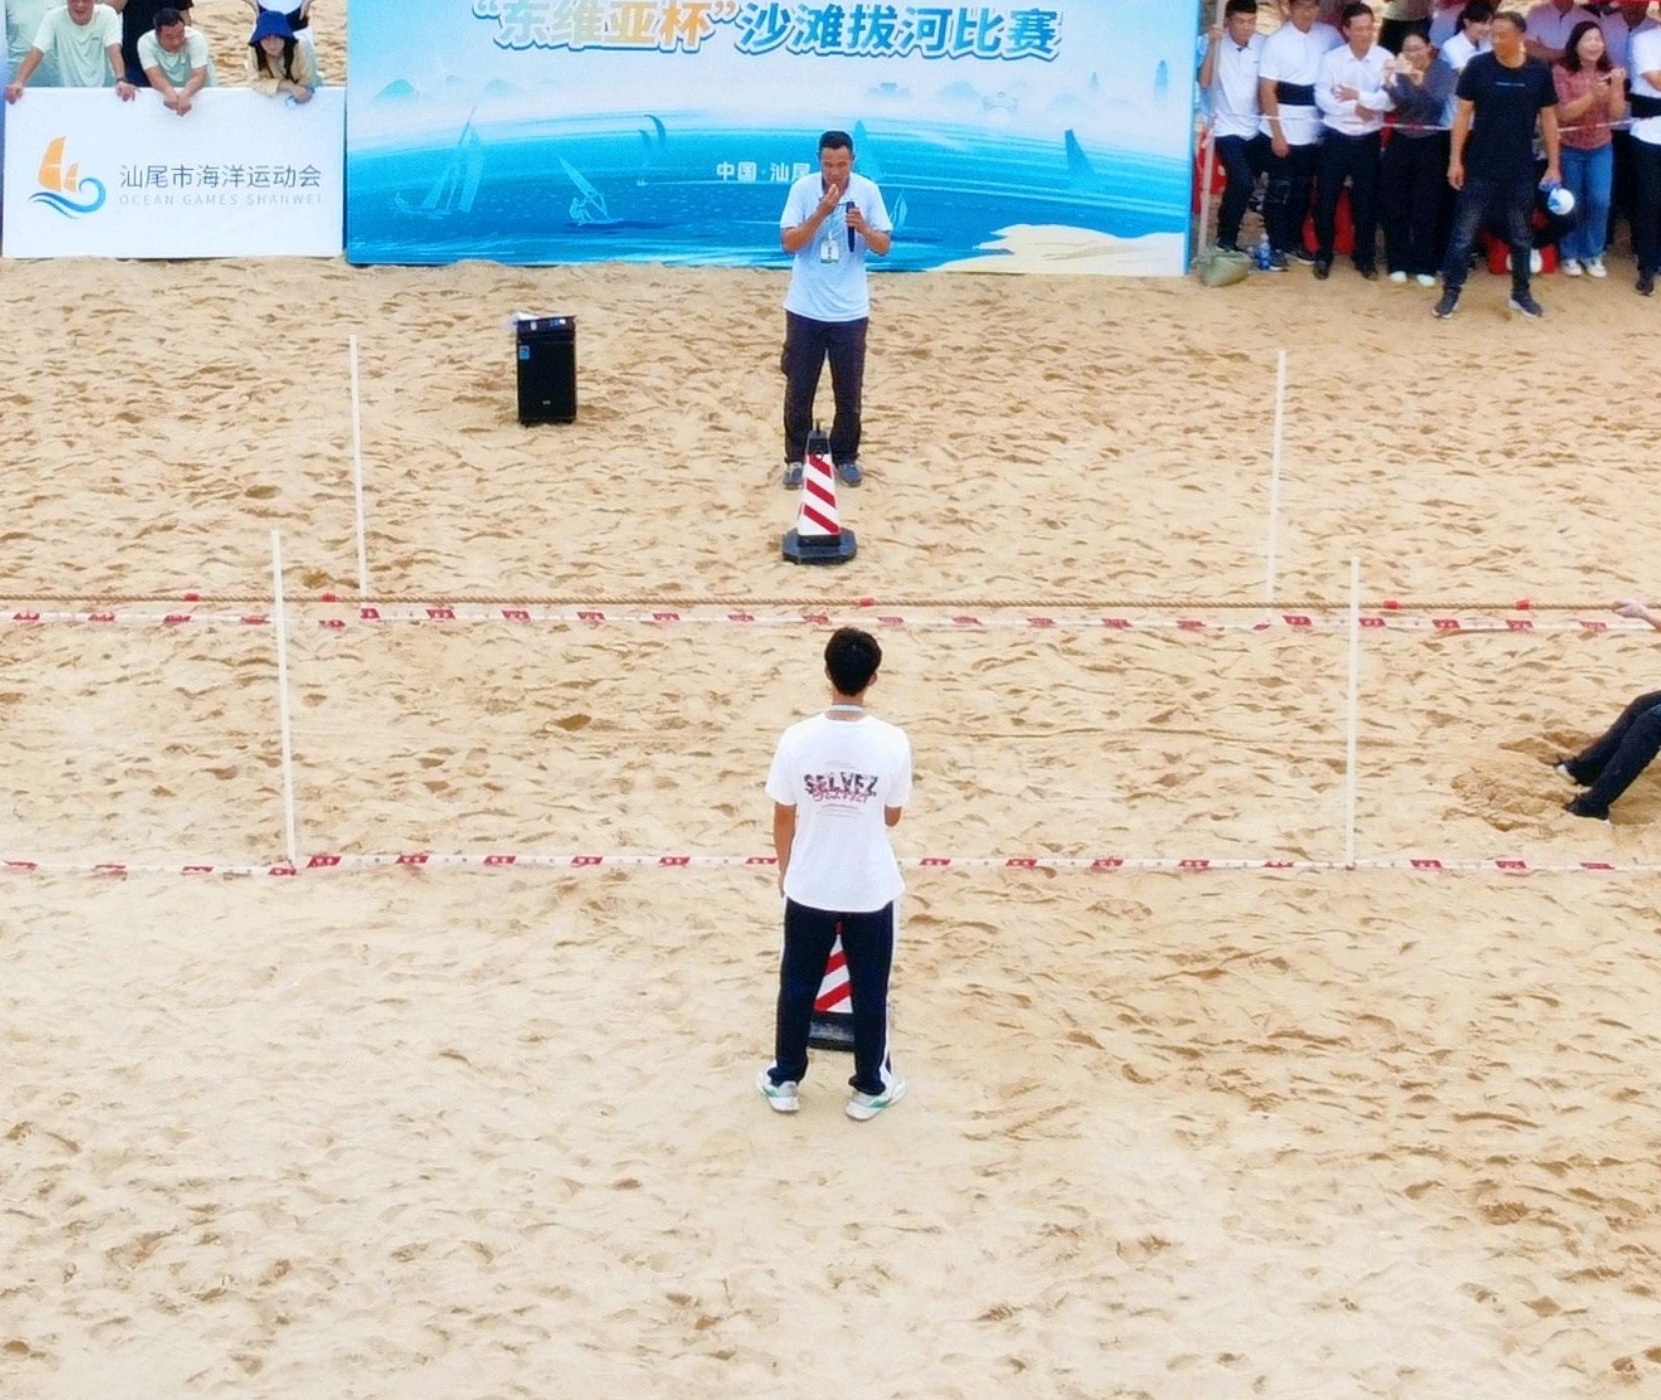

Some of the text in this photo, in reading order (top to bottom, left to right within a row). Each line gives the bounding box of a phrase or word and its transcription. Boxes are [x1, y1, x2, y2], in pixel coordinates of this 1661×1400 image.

[119, 163, 322, 188] 汕尾市海洋运动会
[119, 192, 322, 206] OCEAN GAMES SHANWEI
